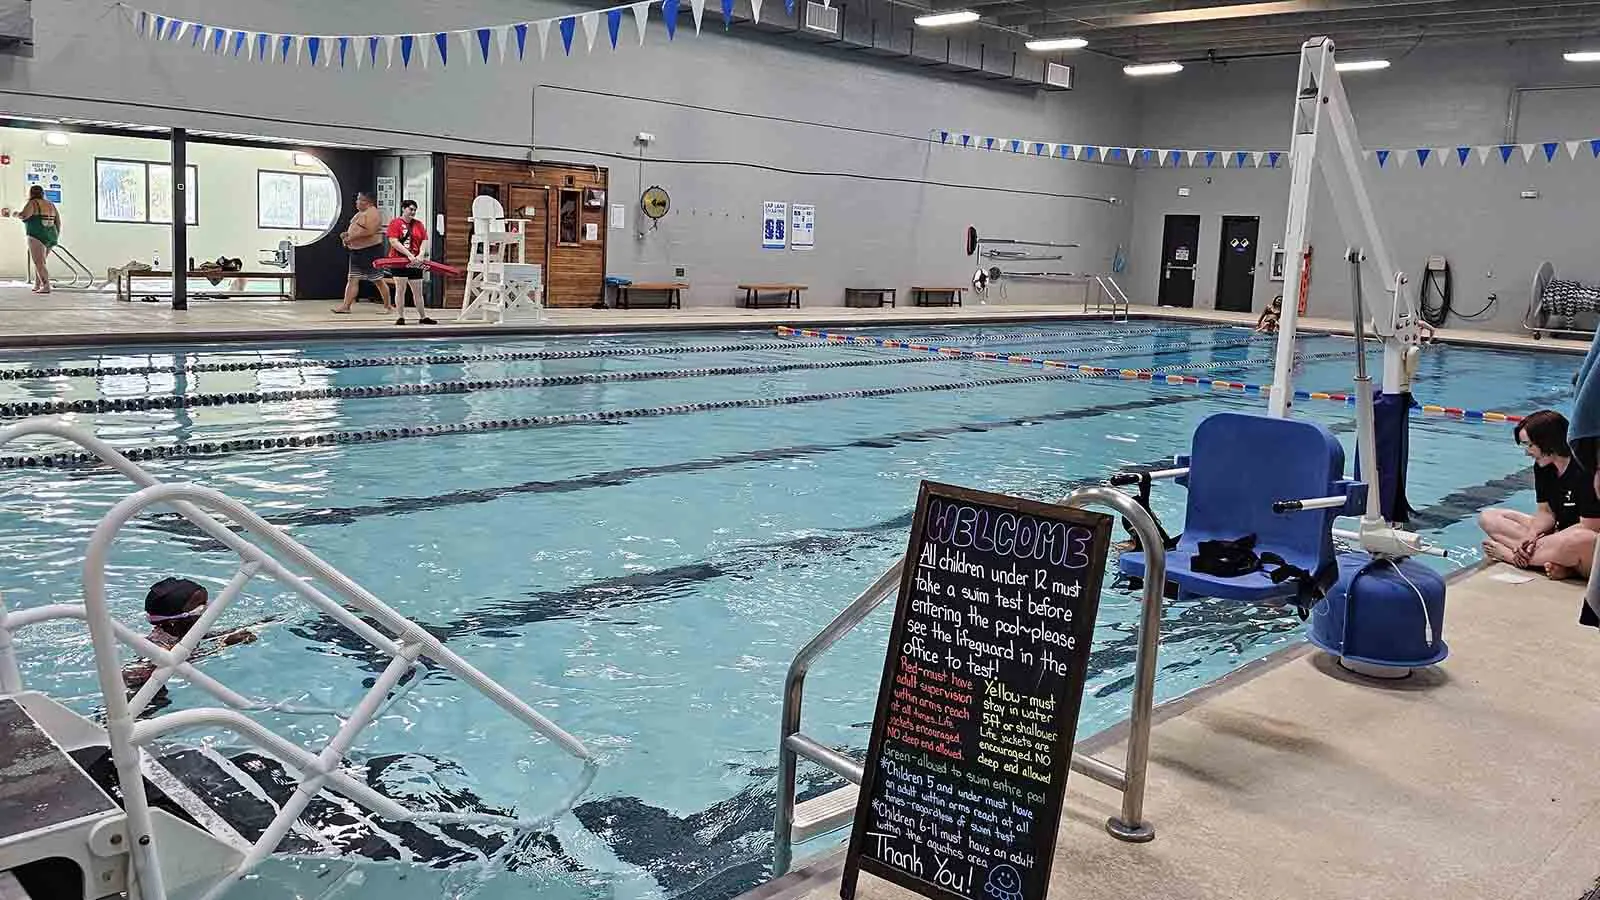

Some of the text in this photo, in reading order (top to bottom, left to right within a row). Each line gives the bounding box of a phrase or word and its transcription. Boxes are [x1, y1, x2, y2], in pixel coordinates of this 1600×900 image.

[927, 499, 1093, 569] WELCOME
[920, 541, 1082, 598] All children under 12 must
[912, 595, 962, 628] entering
[967, 605, 989, 629] the
[915, 568, 1073, 622] take a swim test before
[903, 636, 999, 681] office to test!
[907, 619, 1067, 677] see the lifeguard in the
[896, 673, 972, 704] adult supervision
[901, 656, 973, 689] Red-must have
[894, 688, 970, 720] within arms reach
[902, 705, 911, 715] all
[983, 697, 1053, 723] stay in water
[887, 726, 900, 739] NO
[901, 731, 919, 747] deep
[921, 741, 934, 751] end
[983, 712, 1001, 728] 5ft
[1003, 723, 1014, 731] or
[980, 726, 1050, 753] Life jackets are
[977, 752, 1051, 785] deep end allowed
[1035, 753, 1051, 766] NO
[927, 775, 935, 788] 5
[936, 783, 953, 795] and
[957, 789, 983, 802] under
[985, 797, 1008, 810] must
[1012, 801, 1033, 819] have
[951, 763, 962, 777] to
[966, 772, 990, 788] swim
[992, 778, 1023, 797] entire
[1027, 791, 1046, 805] pool
[885, 779, 1029, 833] an adult within arms reach at all
[876, 820, 989, 869] within the aquatics area
[957, 814, 966, 828] of
[970, 823, 991, 837] swim
[994, 826, 1015, 843] test
[866, 831, 974, 894] Thank You!
[940, 830, 962, 845] must
[968, 835, 991, 855] have
[993, 848, 1007, 860] an
[1009, 851, 1034, 869] adult
